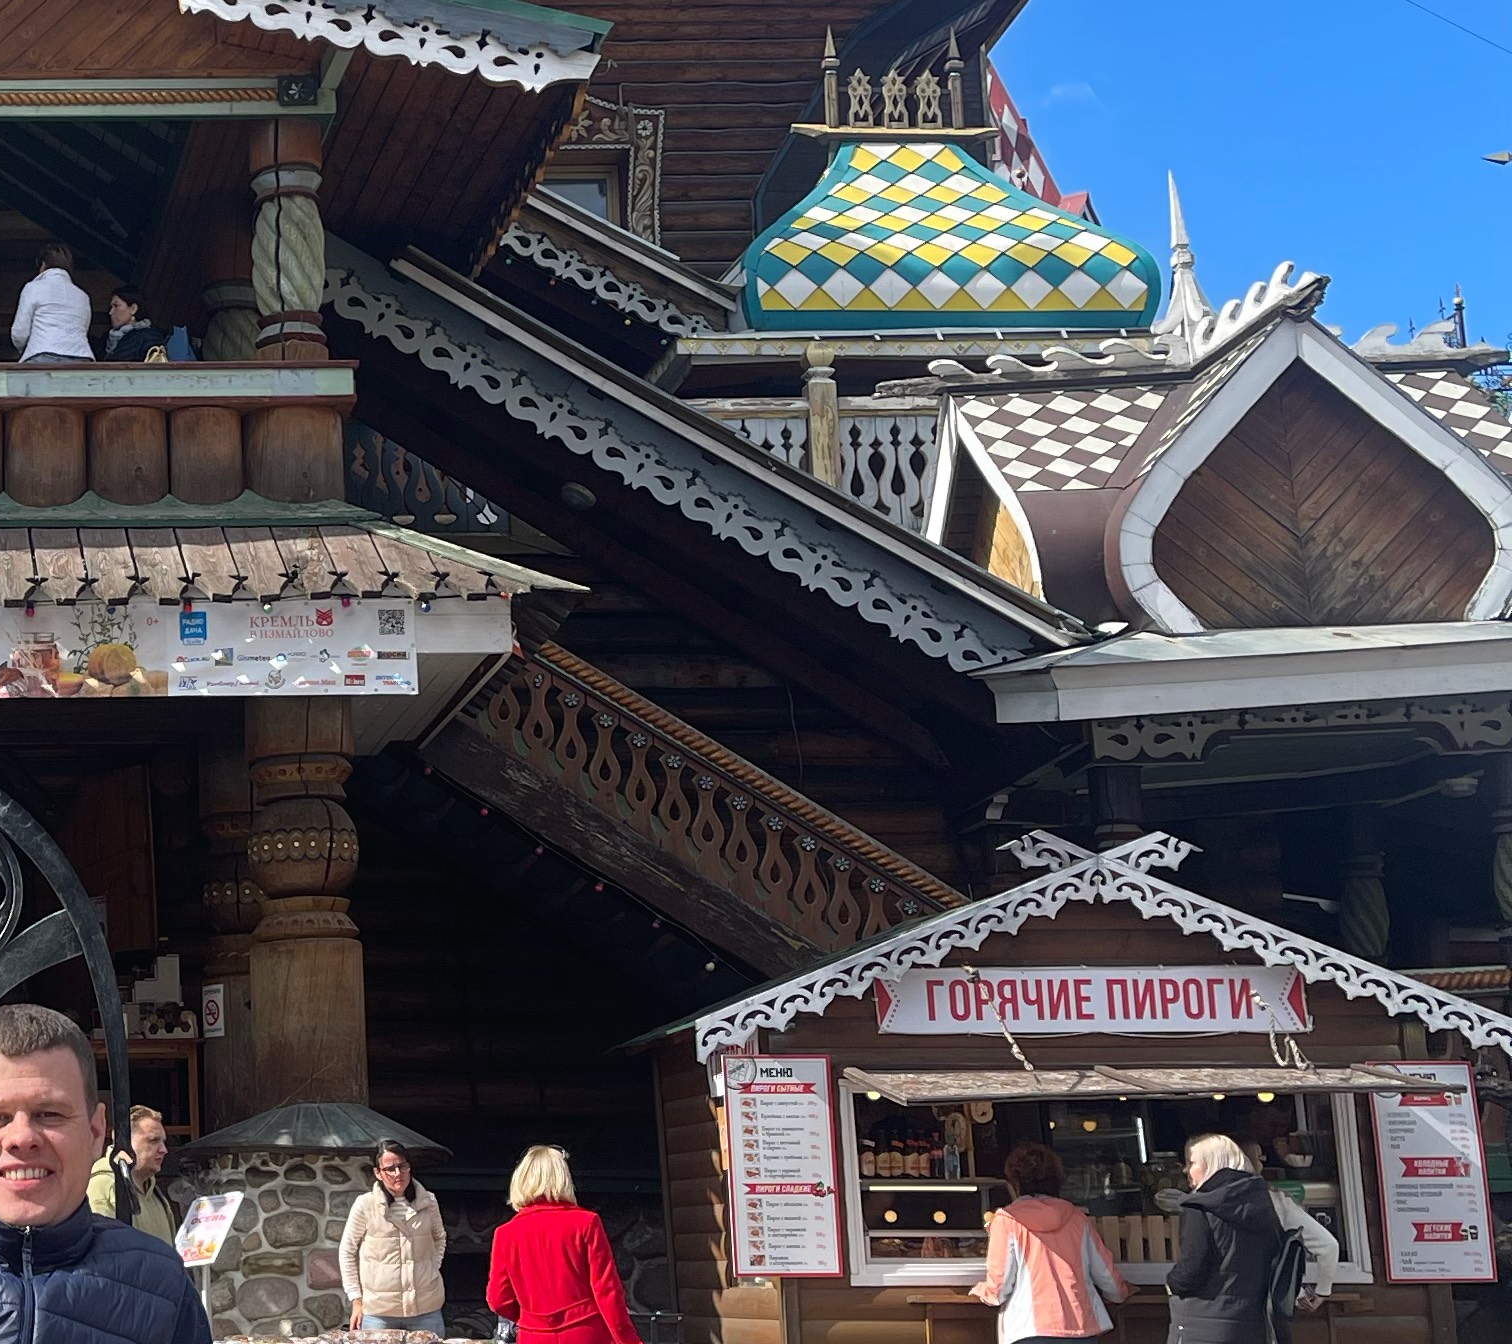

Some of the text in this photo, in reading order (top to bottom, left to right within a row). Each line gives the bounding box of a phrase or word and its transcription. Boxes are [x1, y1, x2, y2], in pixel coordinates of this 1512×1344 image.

[249, 615, 315, 629] КРЕМЛЬ
[249, 627, 334, 639] В ИЗМАЙЛОВО
[926, 977, 1253, 1022] ГОРЯЧИЕ ПИРОГИ
[760, 1067, 793, 1078] МЕНЮ
